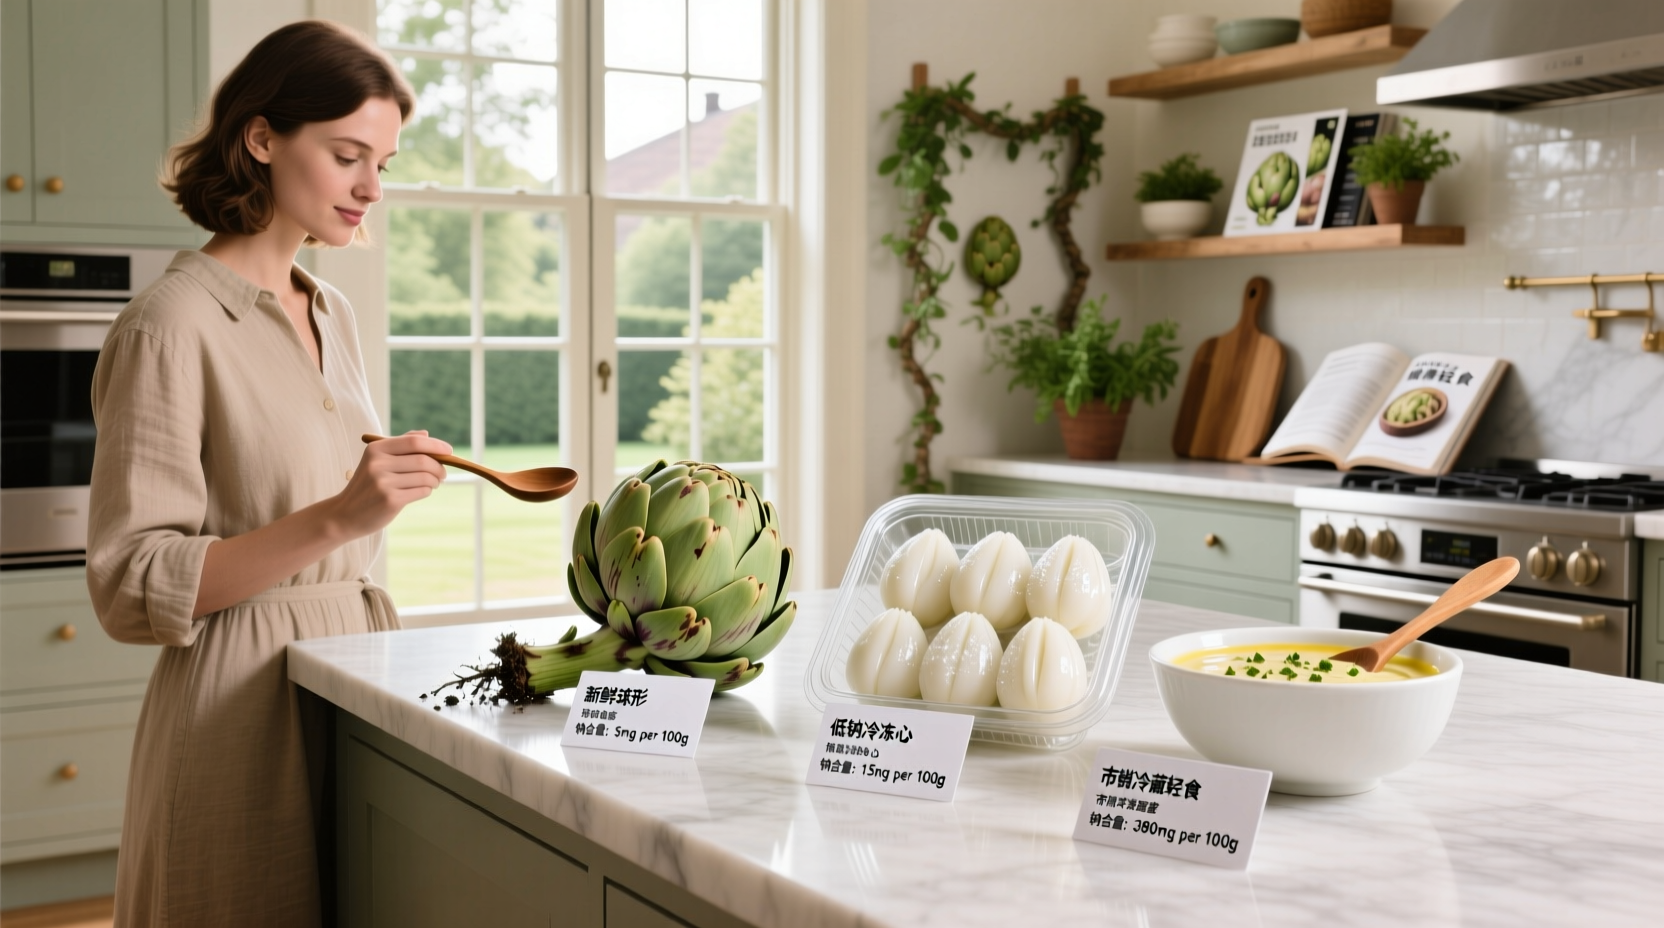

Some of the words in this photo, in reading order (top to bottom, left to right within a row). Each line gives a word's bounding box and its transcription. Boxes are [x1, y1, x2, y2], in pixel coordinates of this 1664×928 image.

[639, 731, 658, 743] per
[662, 730, 689, 747] 100g
[830, 717, 913, 743] 低钠冷冻心
[893, 770, 913, 784] per
[917, 770, 946, 789] 100g
[1178, 830, 1202, 845] per
[1205, 831, 1239, 854] 100g
